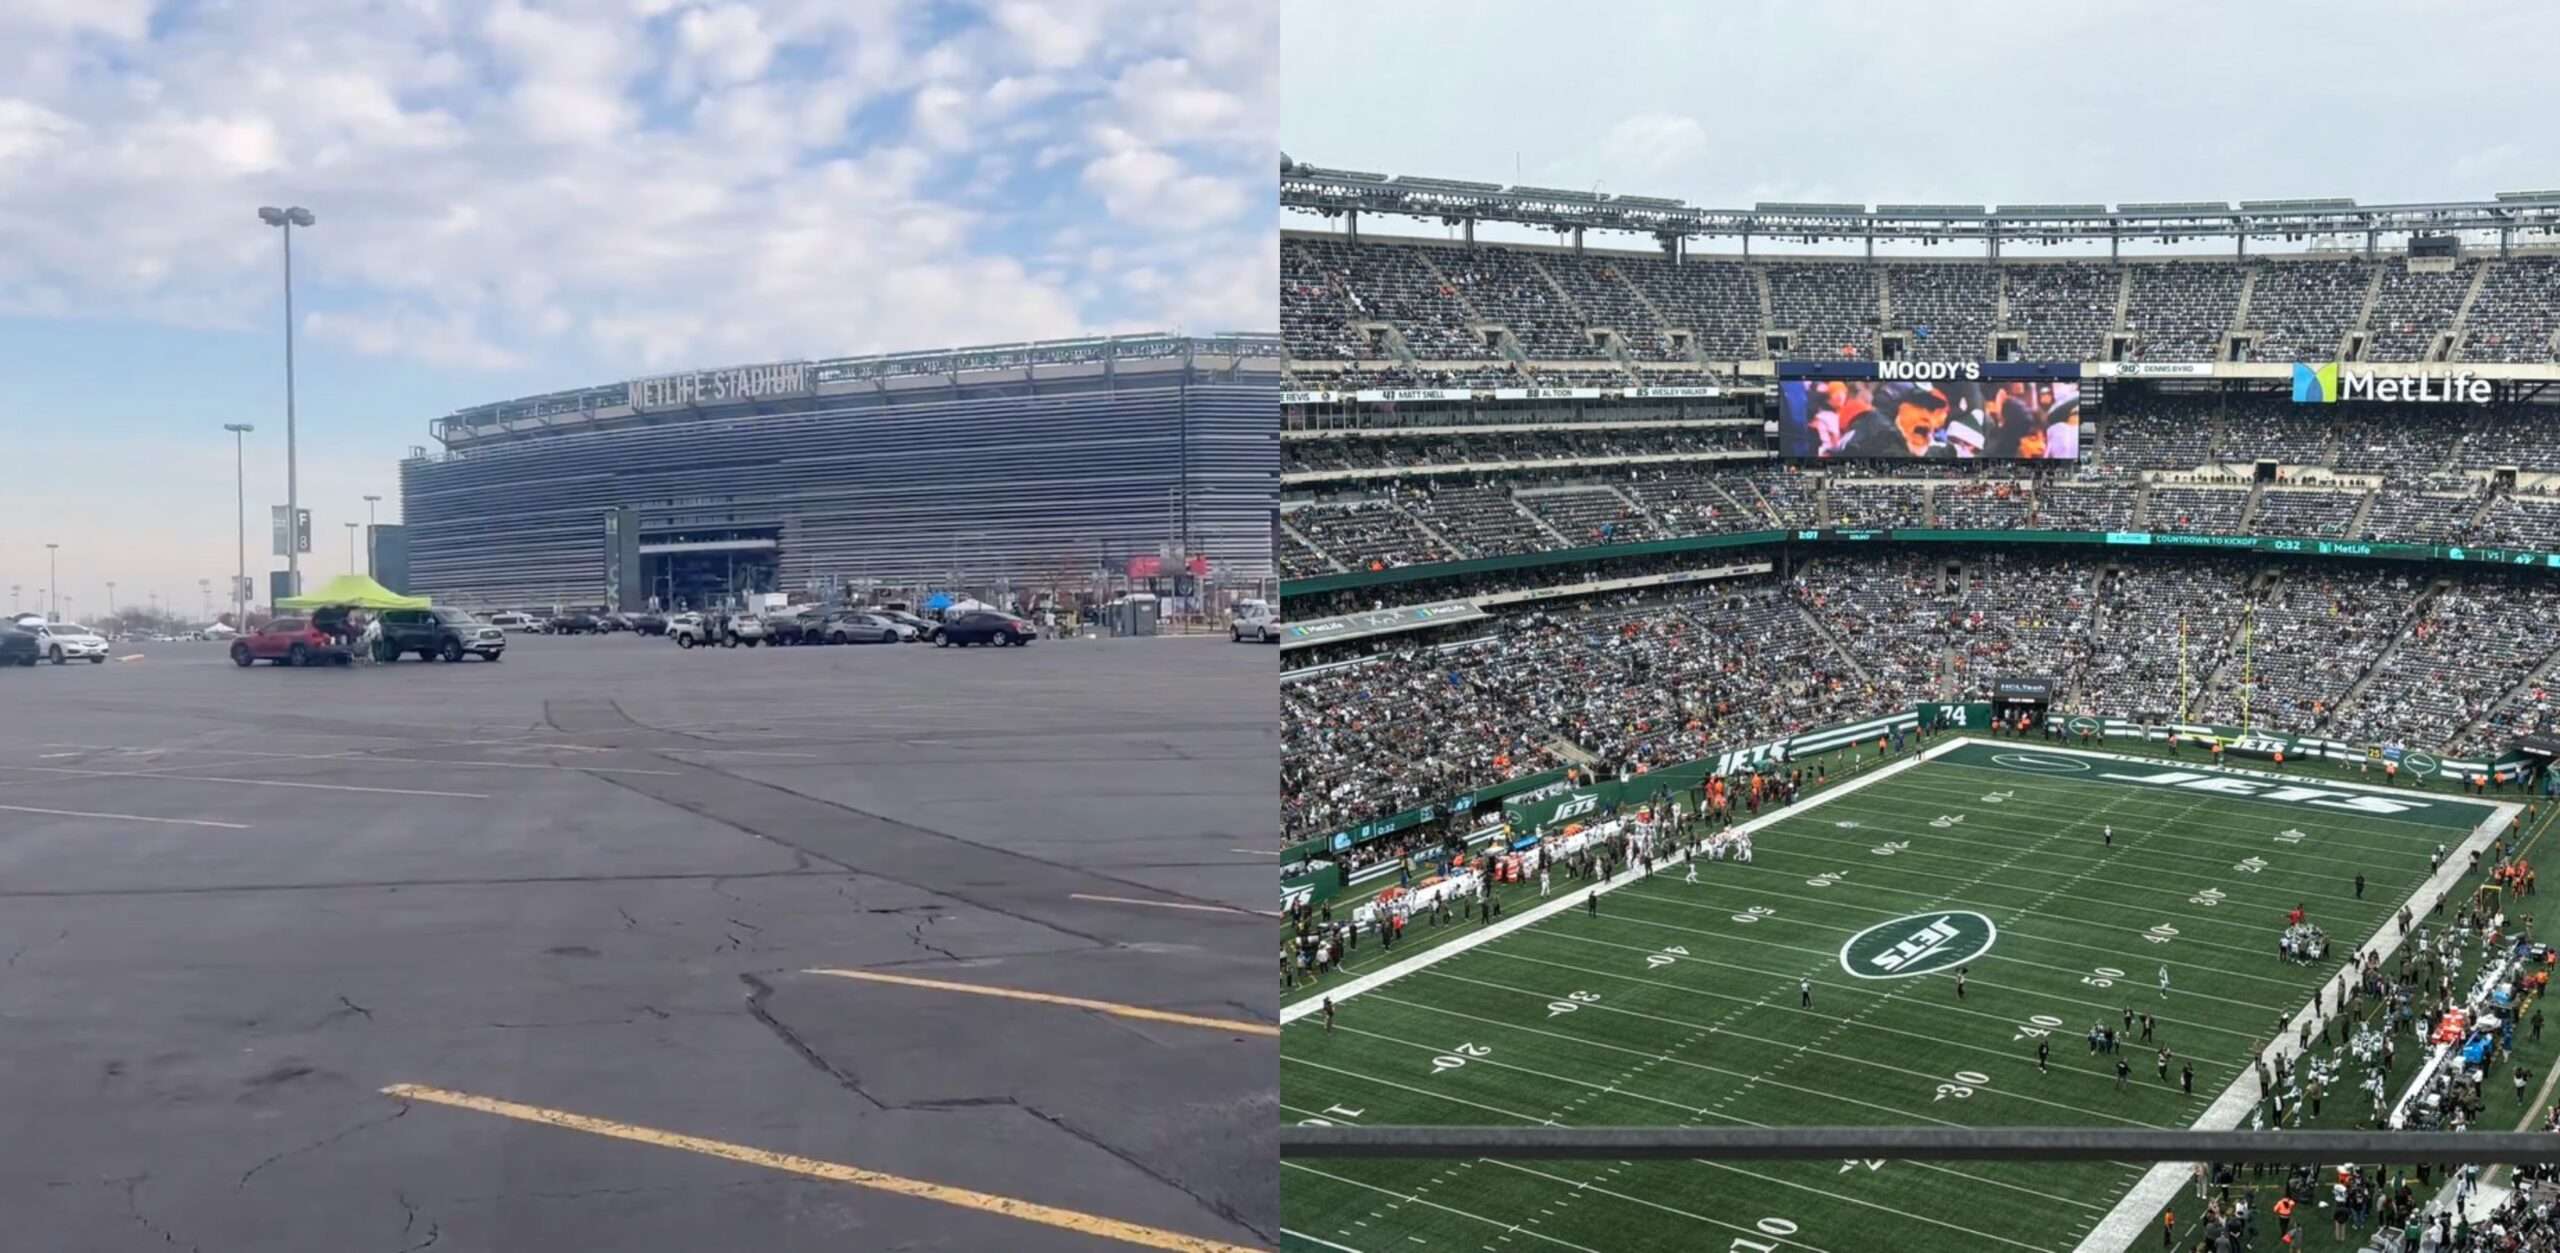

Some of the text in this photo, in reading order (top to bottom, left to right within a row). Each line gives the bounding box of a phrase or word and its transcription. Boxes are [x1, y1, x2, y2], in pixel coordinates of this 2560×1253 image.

[1879, 361, 1980, 380] MOODY'S
[629, 364, 804, 409] METLIFE STADIUM
[2342, 371, 2492, 403] MetLife
[298, 512, 308, 527] F
[299, 535, 308, 549] 8
[2156, 535, 2258, 546] COUNTDOWN TO KICKOFF
[2274, 540, 2301, 550] 0:32
[2333, 544, 2371, 554] MetLife
[1940, 705, 1967, 726] 74
[2226, 735, 2289, 753] JETS
[1716, 739, 1791, 775] JETS
[2098, 772, 2433, 814] JETS
[1547, 796, 1599, 824] JETS
[1731, 905, 1776, 923] 50
[1870, 915, 1961, 972] JETS
[1646, 945, 1689, 965] 40
[1547, 991, 1600, 1013] 30
[2018, 1015, 2063, 1038] 40
[1431, 1042, 1491, 1068] 20
[1936, 1071, 1990, 1098] 30
[1730, 1217, 1799, 1253] 10
